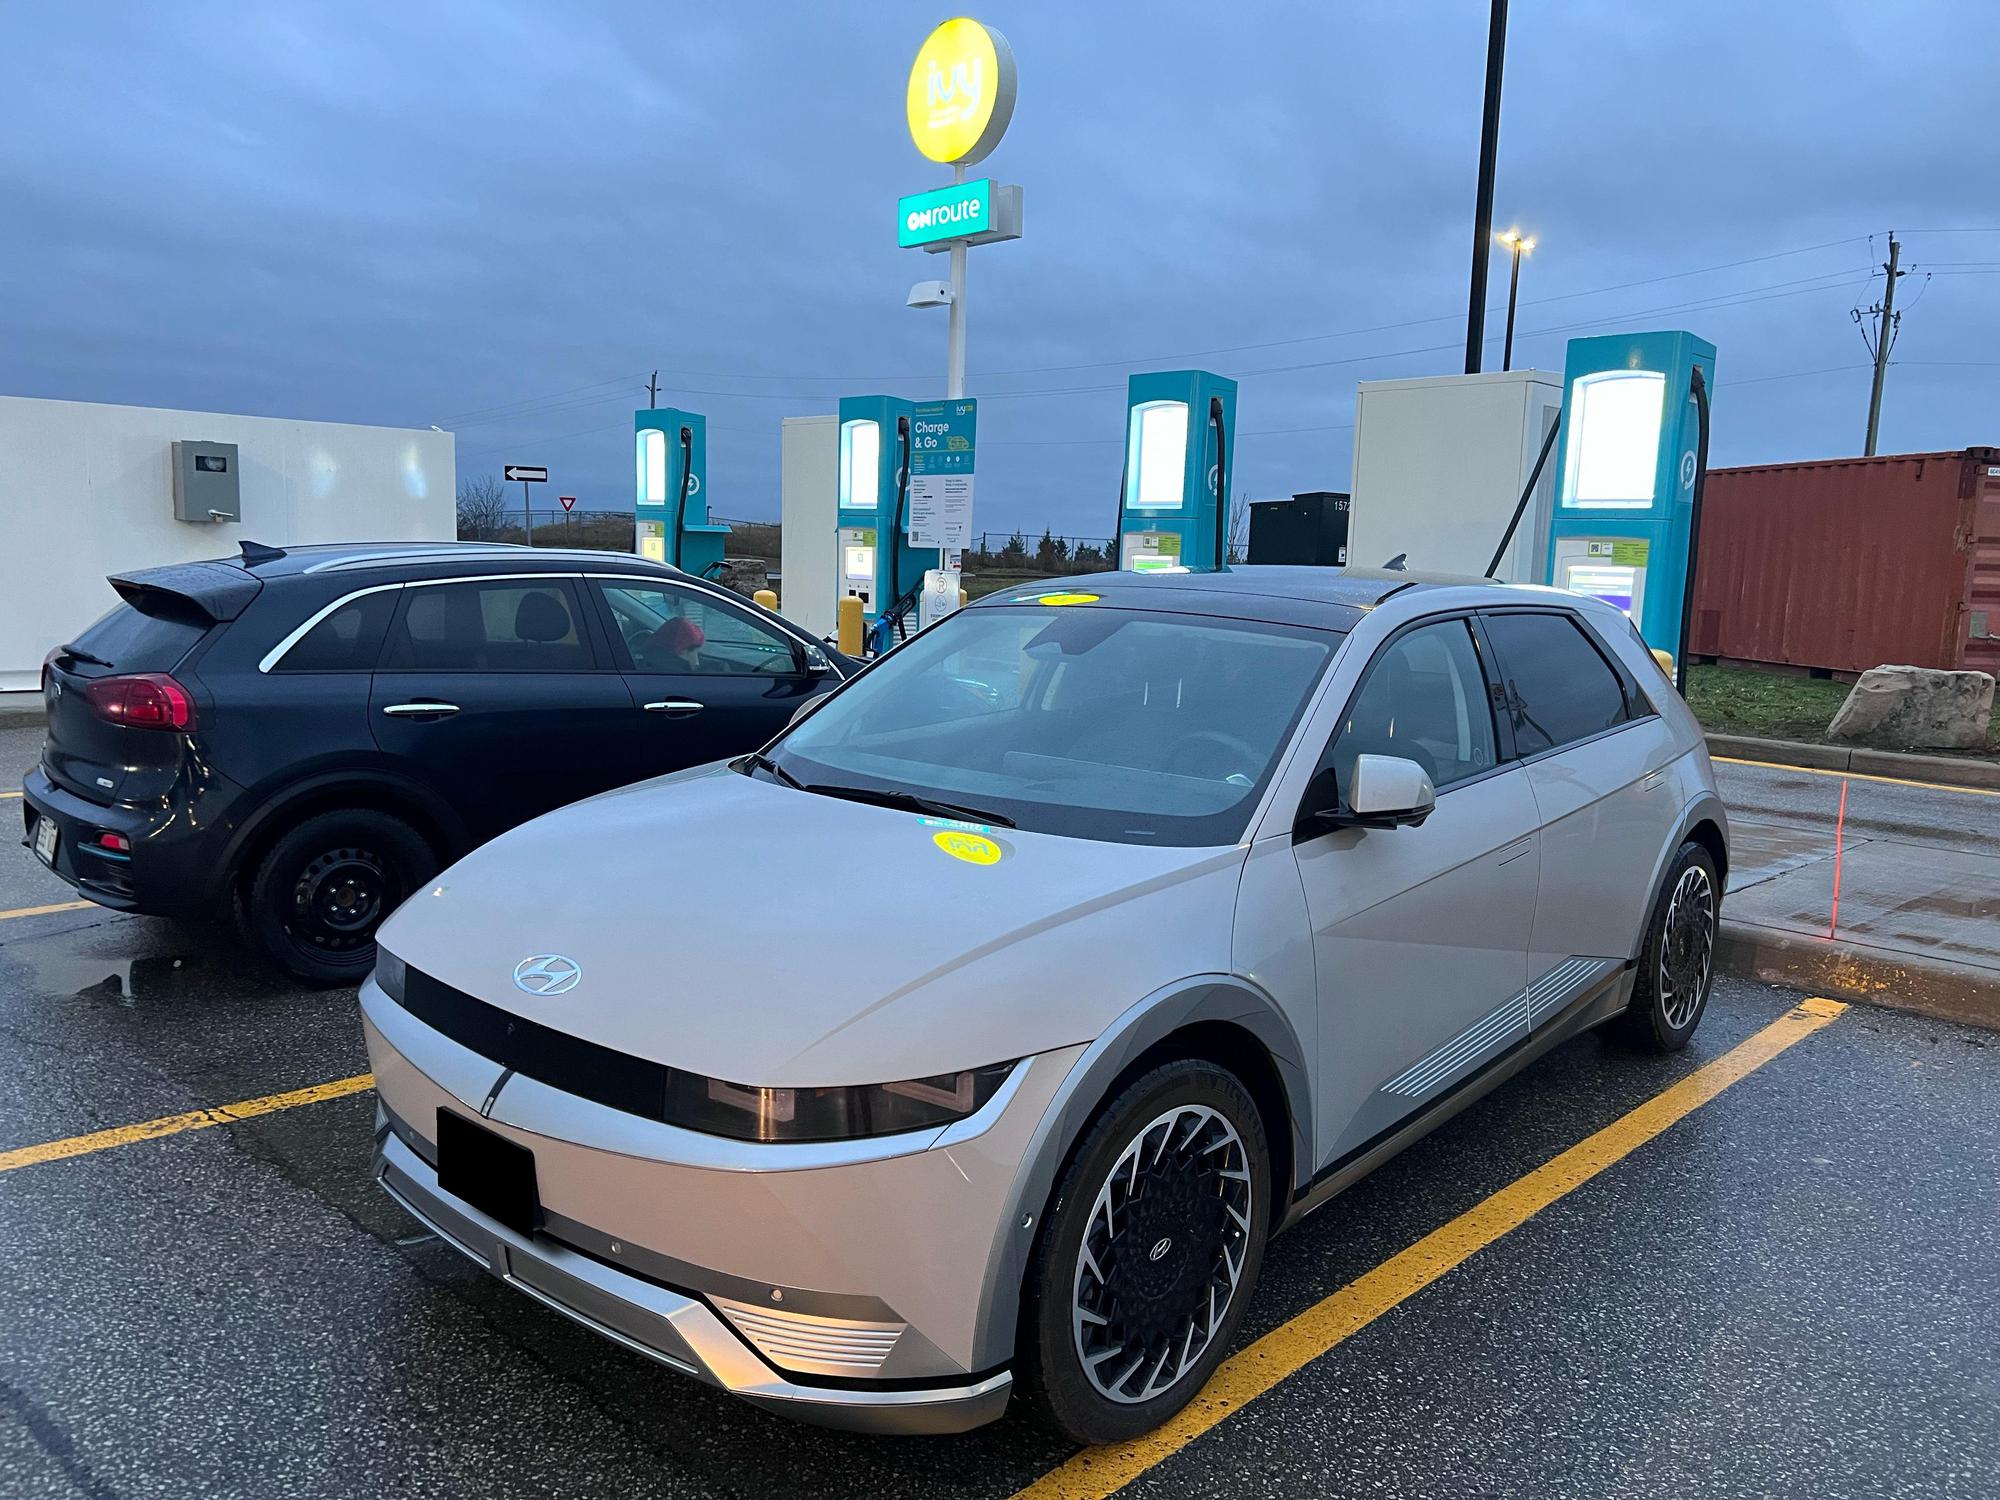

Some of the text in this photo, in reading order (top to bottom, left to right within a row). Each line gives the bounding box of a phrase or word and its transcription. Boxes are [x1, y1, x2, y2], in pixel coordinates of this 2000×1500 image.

[928, 58, 981, 121] ivy
[915, 421, 949, 435] Charge
[915, 436, 938, 449] & Go
